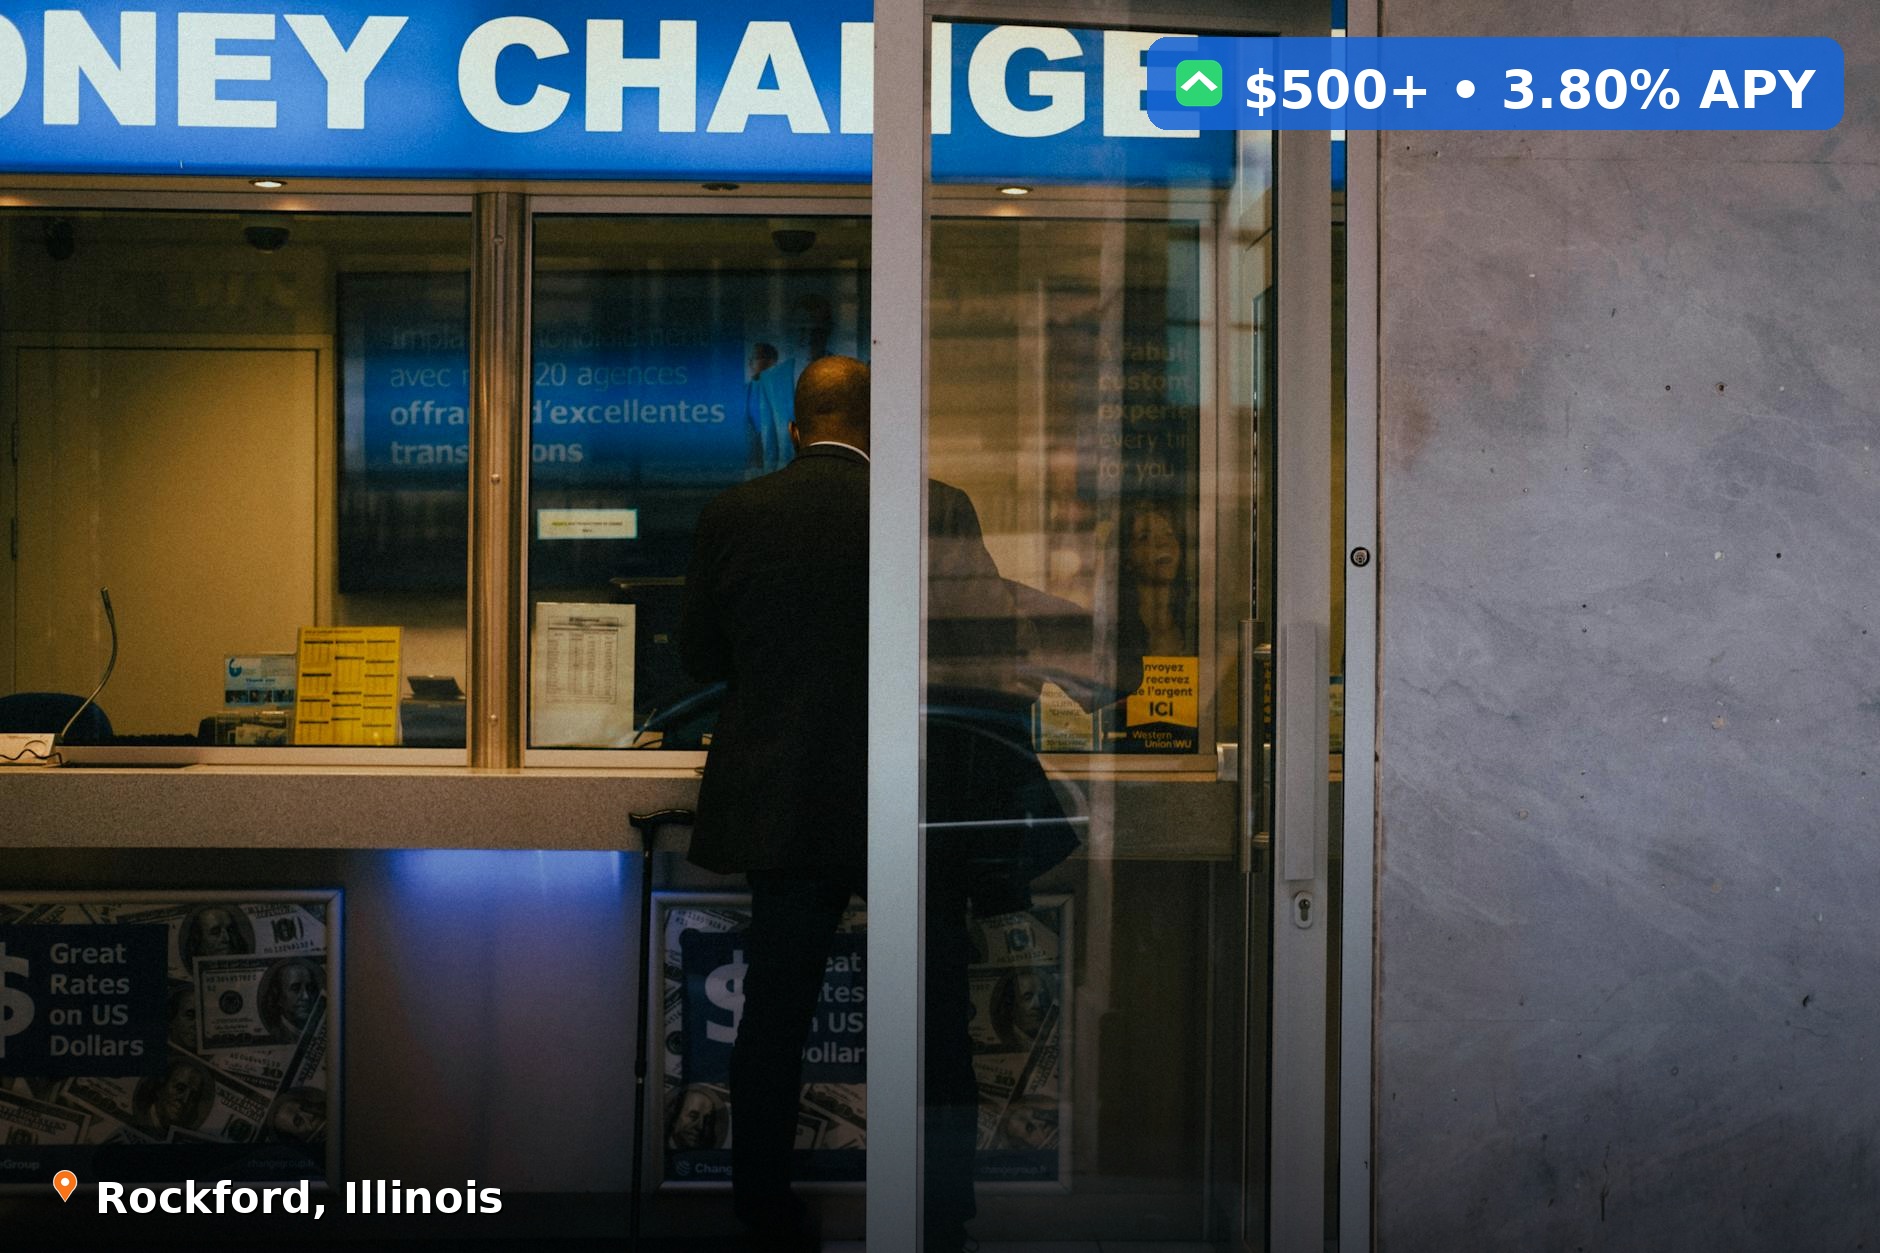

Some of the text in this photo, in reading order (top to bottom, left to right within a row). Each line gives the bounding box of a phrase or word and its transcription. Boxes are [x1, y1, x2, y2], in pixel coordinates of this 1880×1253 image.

[0, 10, 409, 130] NEY
[390, 368, 451, 388] avec
[577, 364, 689, 393] agences
[390, 400, 469, 426] offra
[1136, 461, 1174, 484] you
[1144, 664, 1184, 675] nvoyez
[1146, 676, 1190, 684] recevez
[1147, 686, 1193, 698] l'argent
[1149, 702, 1174, 717] ICI
[1132, 730, 1173, 740] Western
[50, 942, 127, 965] Great
[825, 951, 862, 973] eat
[50, 973, 130, 995] Rates
[817, 982, 865, 1003] tes
[49, 1003, 129, 1026] on US
[828, 1012, 864, 1033] US
[50, 1033, 144, 1057] Dollars
[801, 1041, 866, 1063] ollar
